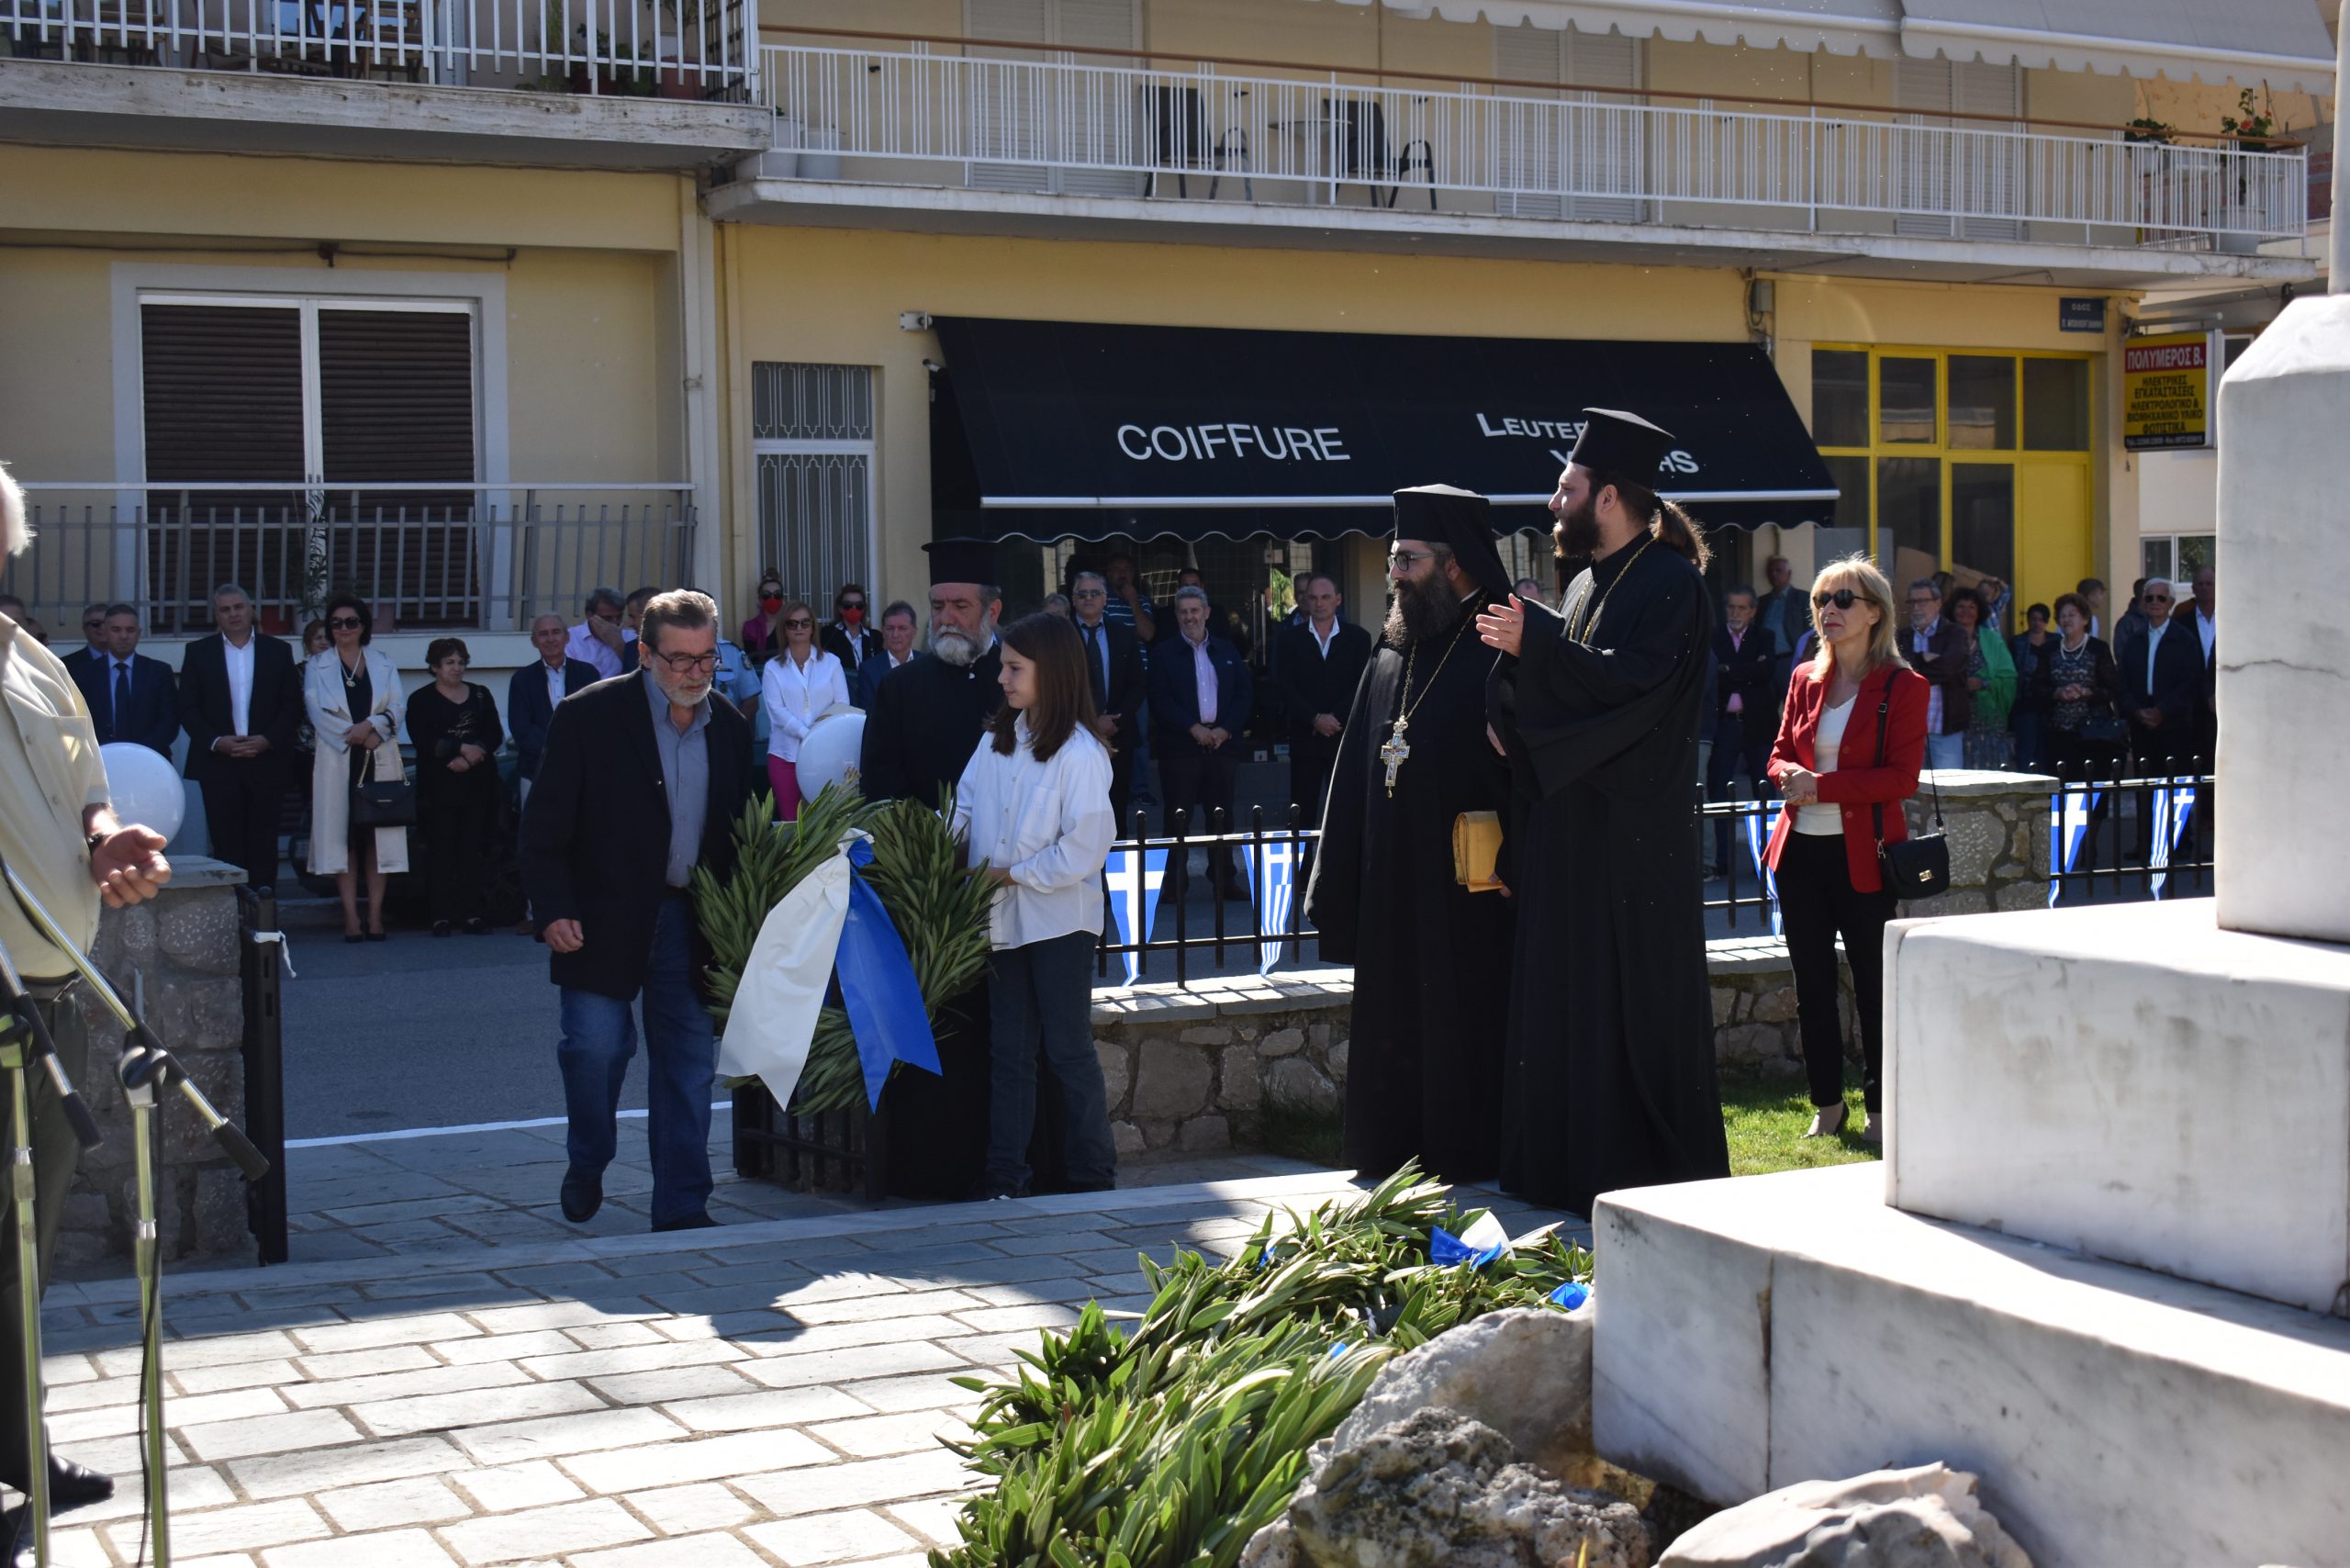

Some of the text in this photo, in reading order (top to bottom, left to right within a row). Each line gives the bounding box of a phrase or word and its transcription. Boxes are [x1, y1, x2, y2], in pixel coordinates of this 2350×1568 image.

[2127, 348, 2191, 369] ΠΟΛΥΜΕΡΟΣ
[2143, 375, 2188, 386] ΗΛΕΚΤΡΙΚΕΣ
[2134, 386, 2195, 398] ΕΓΚΑΤΑΣΤΑΣΕΙΣ
[1117, 423, 1351, 461] COIFFURE
